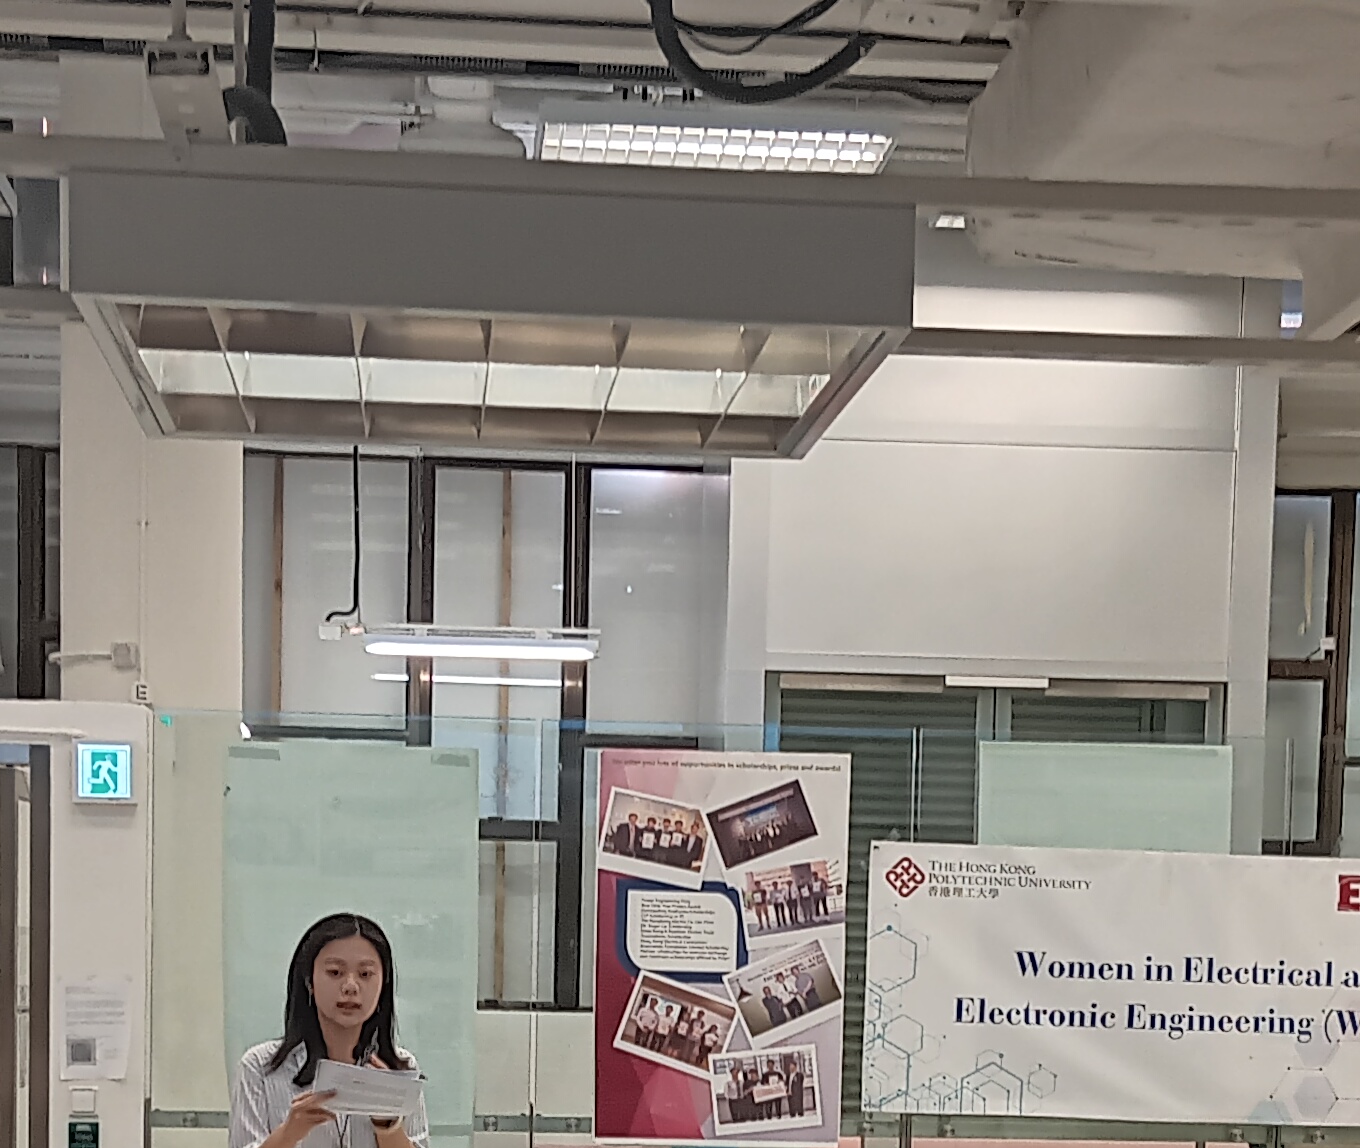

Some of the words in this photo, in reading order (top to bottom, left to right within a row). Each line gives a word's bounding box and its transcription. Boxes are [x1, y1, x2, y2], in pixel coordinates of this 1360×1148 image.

[135, 684, 148, 700] E
[928, 860, 956, 872] THE
[958, 861, 997, 874] HONG
[999, 863, 1037, 876] KONG
[928, 873, 1016, 888] POLYTECHNIC
[1018, 876, 1092, 890] UNIVERSITY
[928, 886, 1000, 899] 香港理工大學
[1014, 950, 1135, 981] Women
[1143, 955, 1175, 982] in
[1182, 956, 1334, 987] Electrical
[952, 997, 1116, 1029] Electronic
[1125, 1003, 1315, 1044] Engineering
